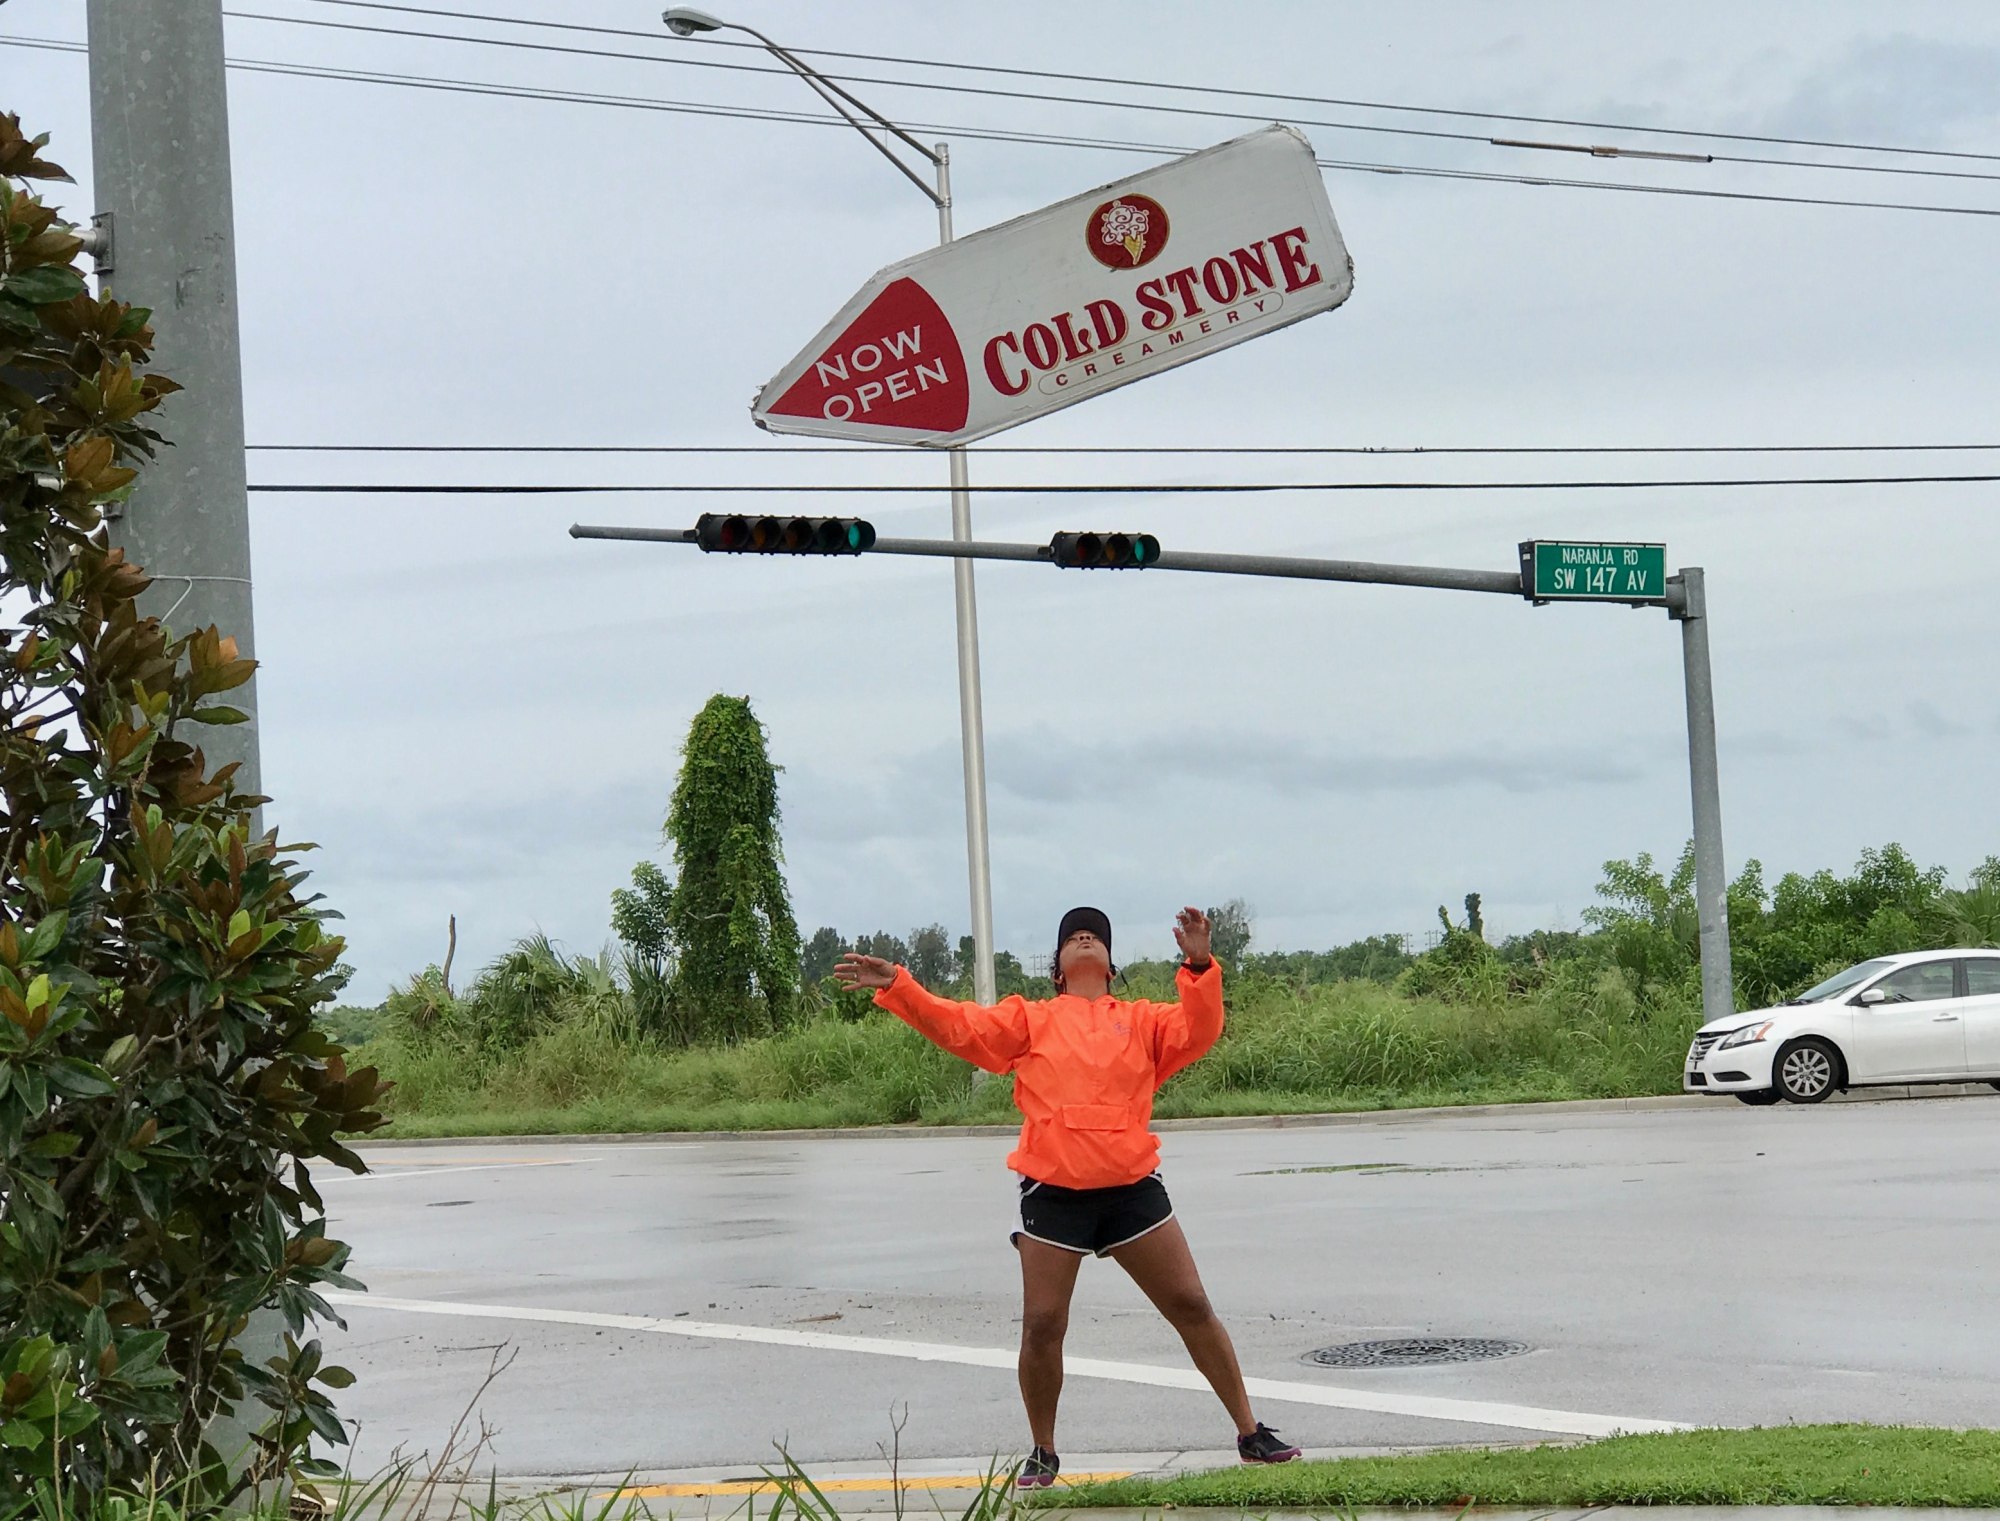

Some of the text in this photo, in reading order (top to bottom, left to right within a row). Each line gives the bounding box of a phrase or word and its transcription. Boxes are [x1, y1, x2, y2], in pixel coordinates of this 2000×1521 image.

[984, 226, 1323, 396] COLD STONE
[1055, 299, 1266, 386] CREAMERY
[815, 324, 921, 388] NOW
[823, 357, 949, 421] OPEN
[1553, 567, 1647, 592] SW 147 AV
[1562, 548, 1638, 565] NARANJA RD
